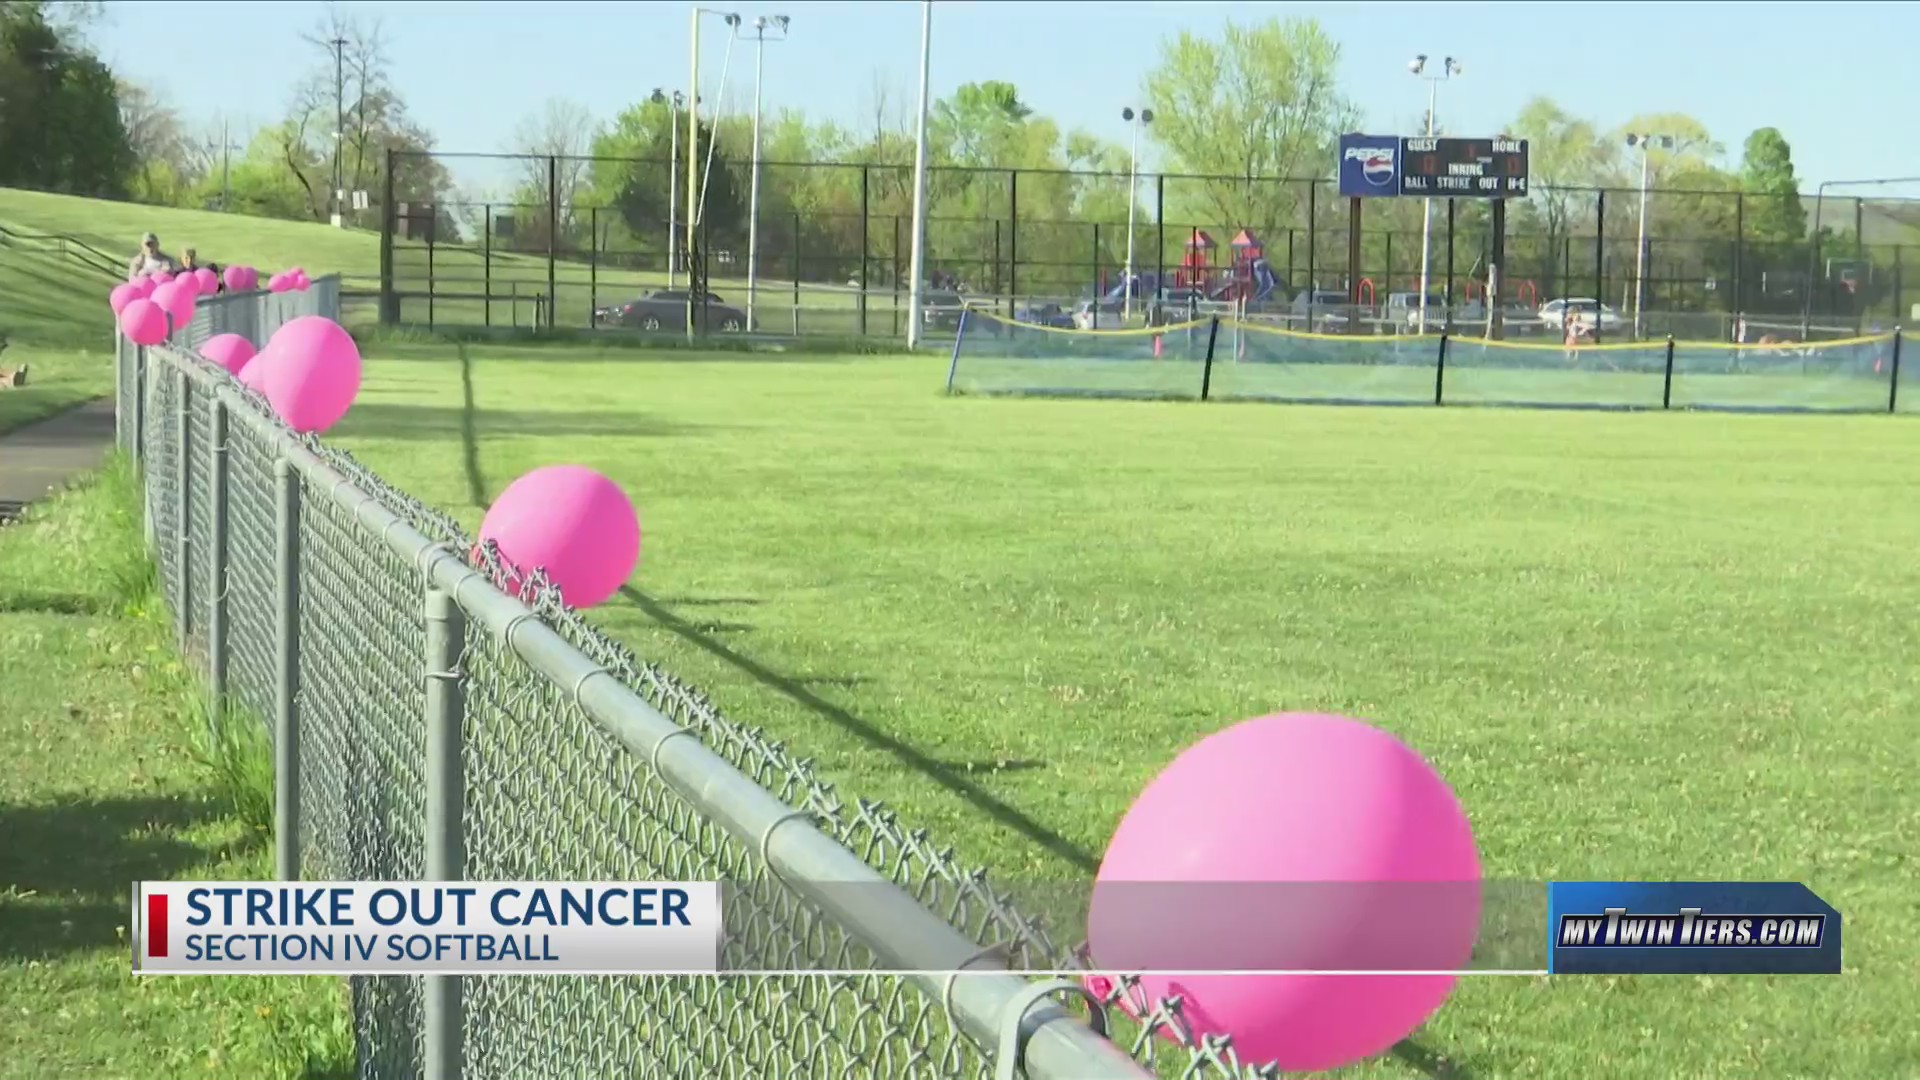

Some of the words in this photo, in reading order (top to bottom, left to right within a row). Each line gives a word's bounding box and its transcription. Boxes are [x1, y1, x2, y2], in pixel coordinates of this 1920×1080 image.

[1407, 139, 1437, 151] GUEST
[1492, 141, 1521, 153] HOME
[1344, 147, 1395, 162] PEPSI
[1448, 163, 1484, 176] INNING
[1404, 176, 1428, 189] BALL
[1437, 177, 1471, 189] STRIKE
[1478, 177, 1499, 189] OUT
